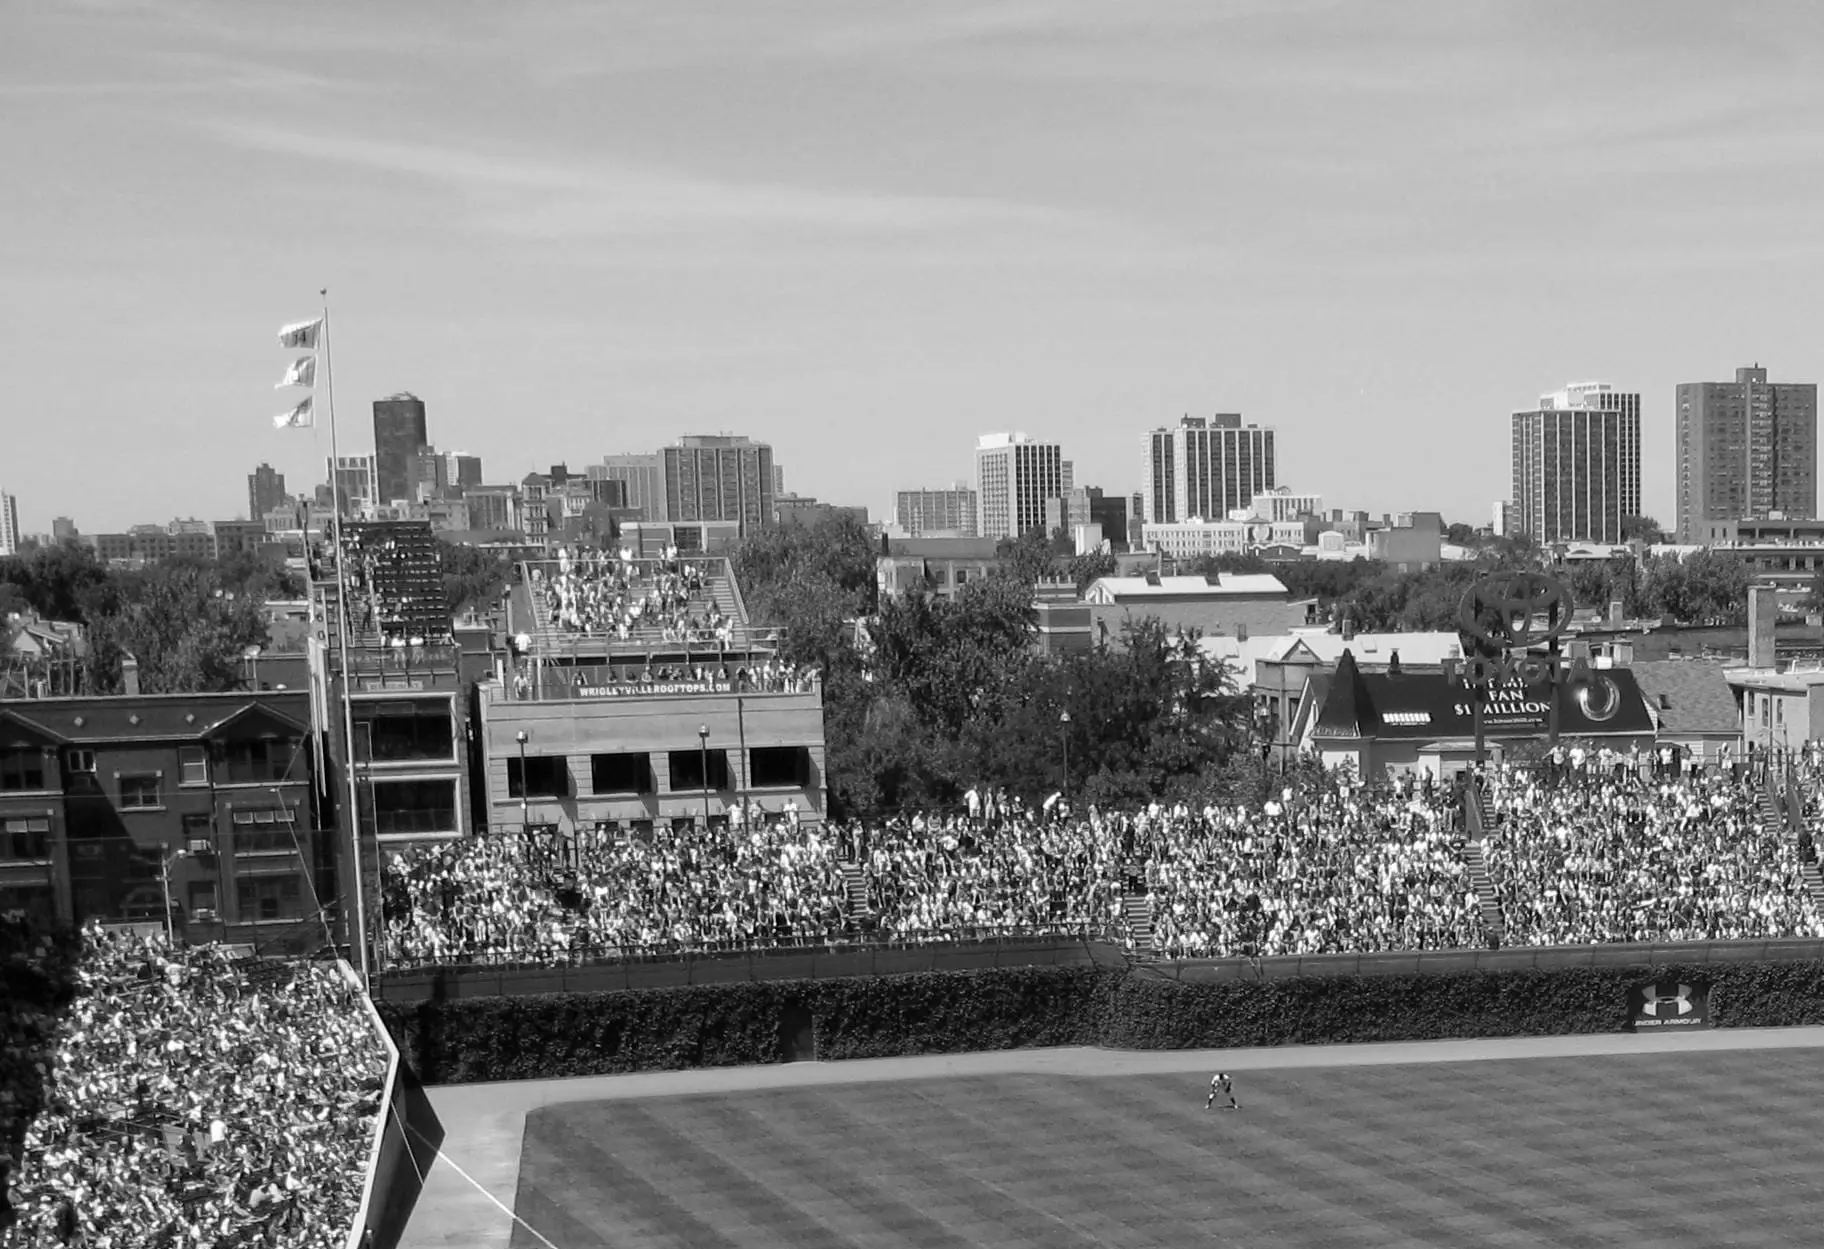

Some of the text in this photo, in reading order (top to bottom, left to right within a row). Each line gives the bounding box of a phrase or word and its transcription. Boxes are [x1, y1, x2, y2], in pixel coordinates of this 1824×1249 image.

[1441, 655, 1594, 686] TOYOTA
[1489, 689, 1524, 701] FAN
[1454, 703, 1472, 716] $1
